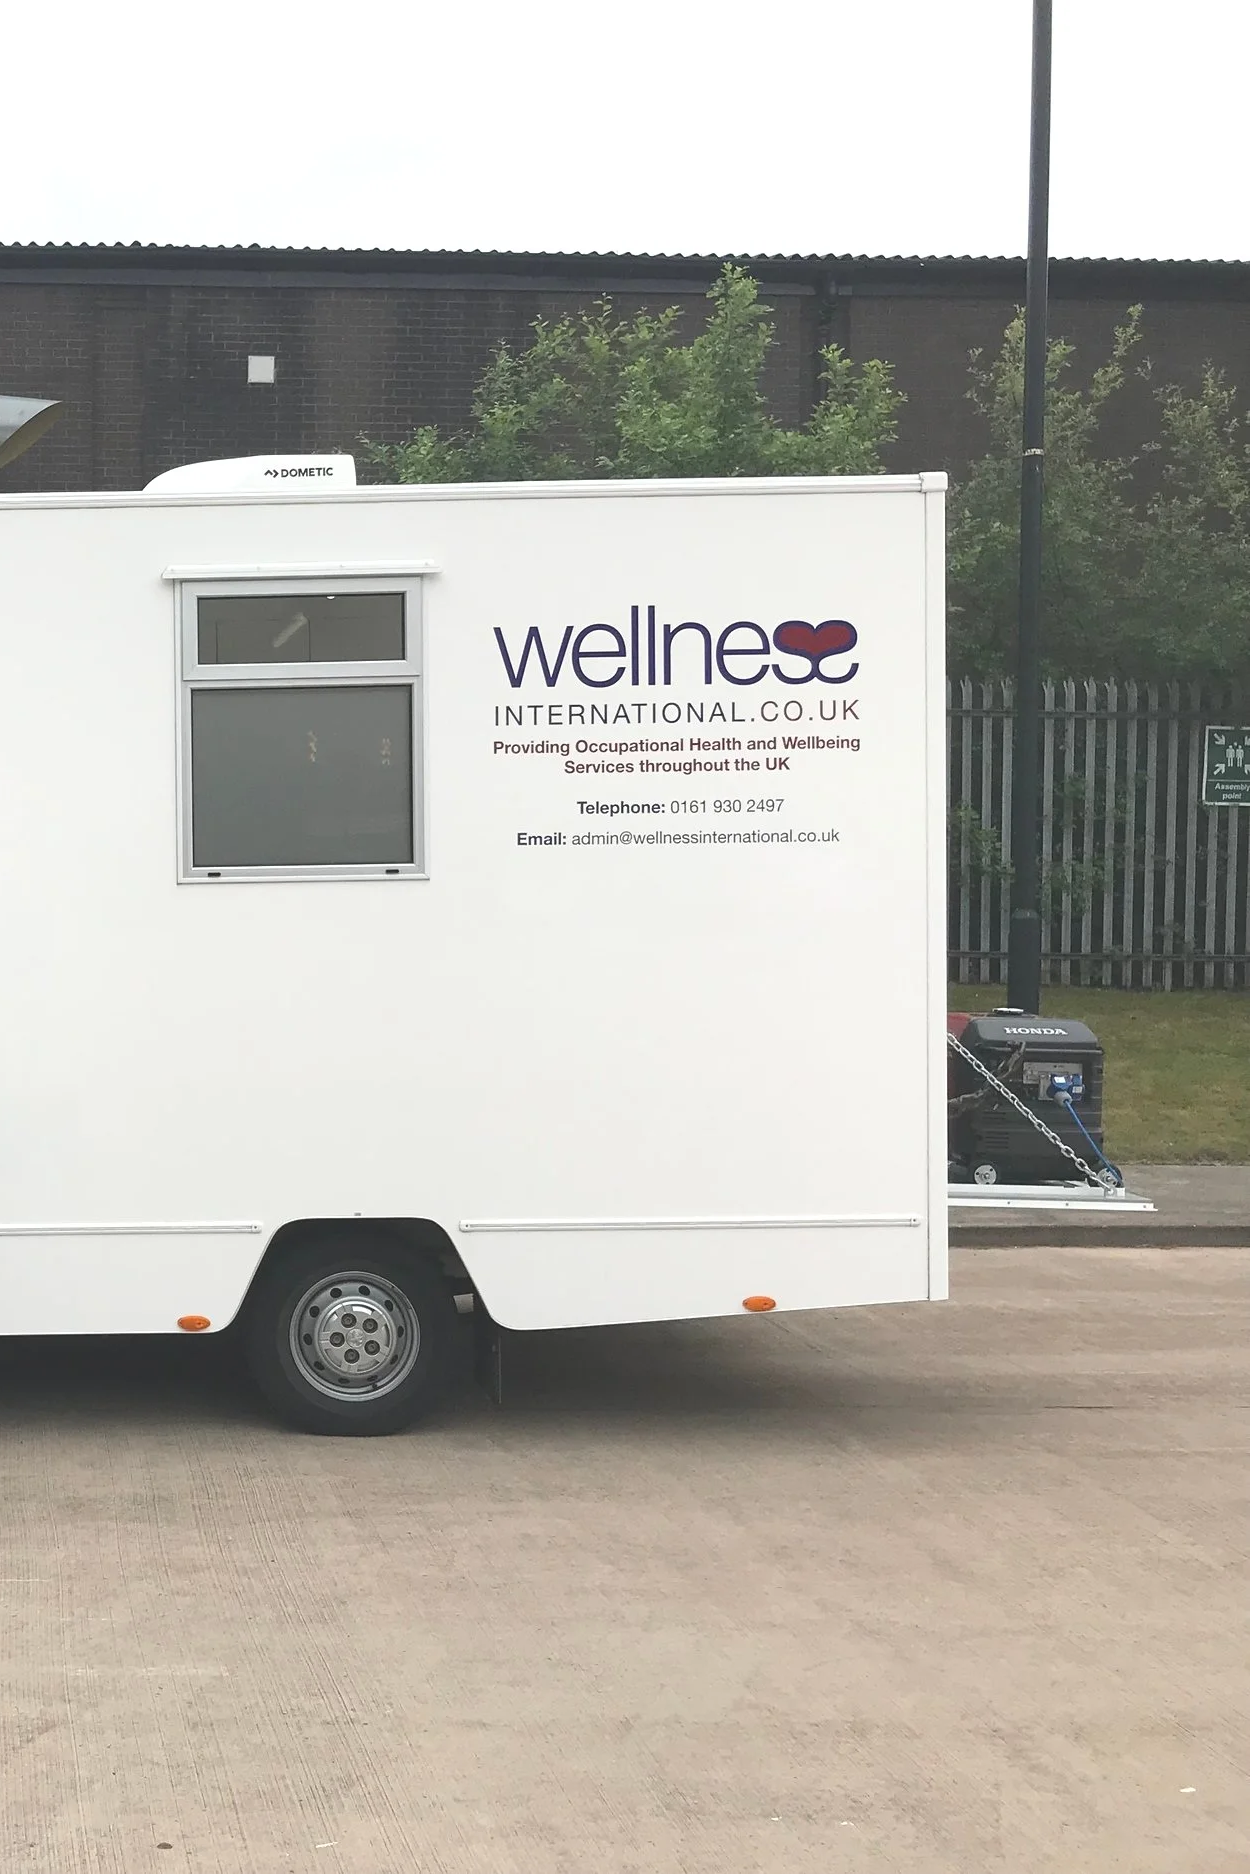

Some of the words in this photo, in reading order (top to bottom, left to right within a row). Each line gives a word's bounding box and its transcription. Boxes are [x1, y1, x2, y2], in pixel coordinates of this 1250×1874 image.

[280, 467, 334, 478] DOMETIC
[493, 605, 860, 688] wellness
[494, 699, 861, 726] INTERNATIONAL.CO.UK
[493, 740, 570, 756] Providing
[575, 738, 684, 755] Occupational
[689, 737, 742, 751] Health
[746, 736, 777, 750] and
[782, 735, 861, 751] Wellbeing
[564, 760, 634, 774] Services
[639, 758, 730, 775] throughout
[734, 757, 760, 771] the
[765, 756, 791, 770] UK
[1214, 782, 1250, 792] Assembly
[1222, 792, 1242, 800] point
[577, 801, 666, 817] Telephone:
[670, 800, 707, 814] 0161
[713, 799, 742, 813] 930
[746, 798, 785, 813] 2497
[517, 832, 567, 846] Email:
[571, 828, 840, 846] admin@wellnessinternational.co.uk
[1003, 1027, 1069, 1036] HONDA
